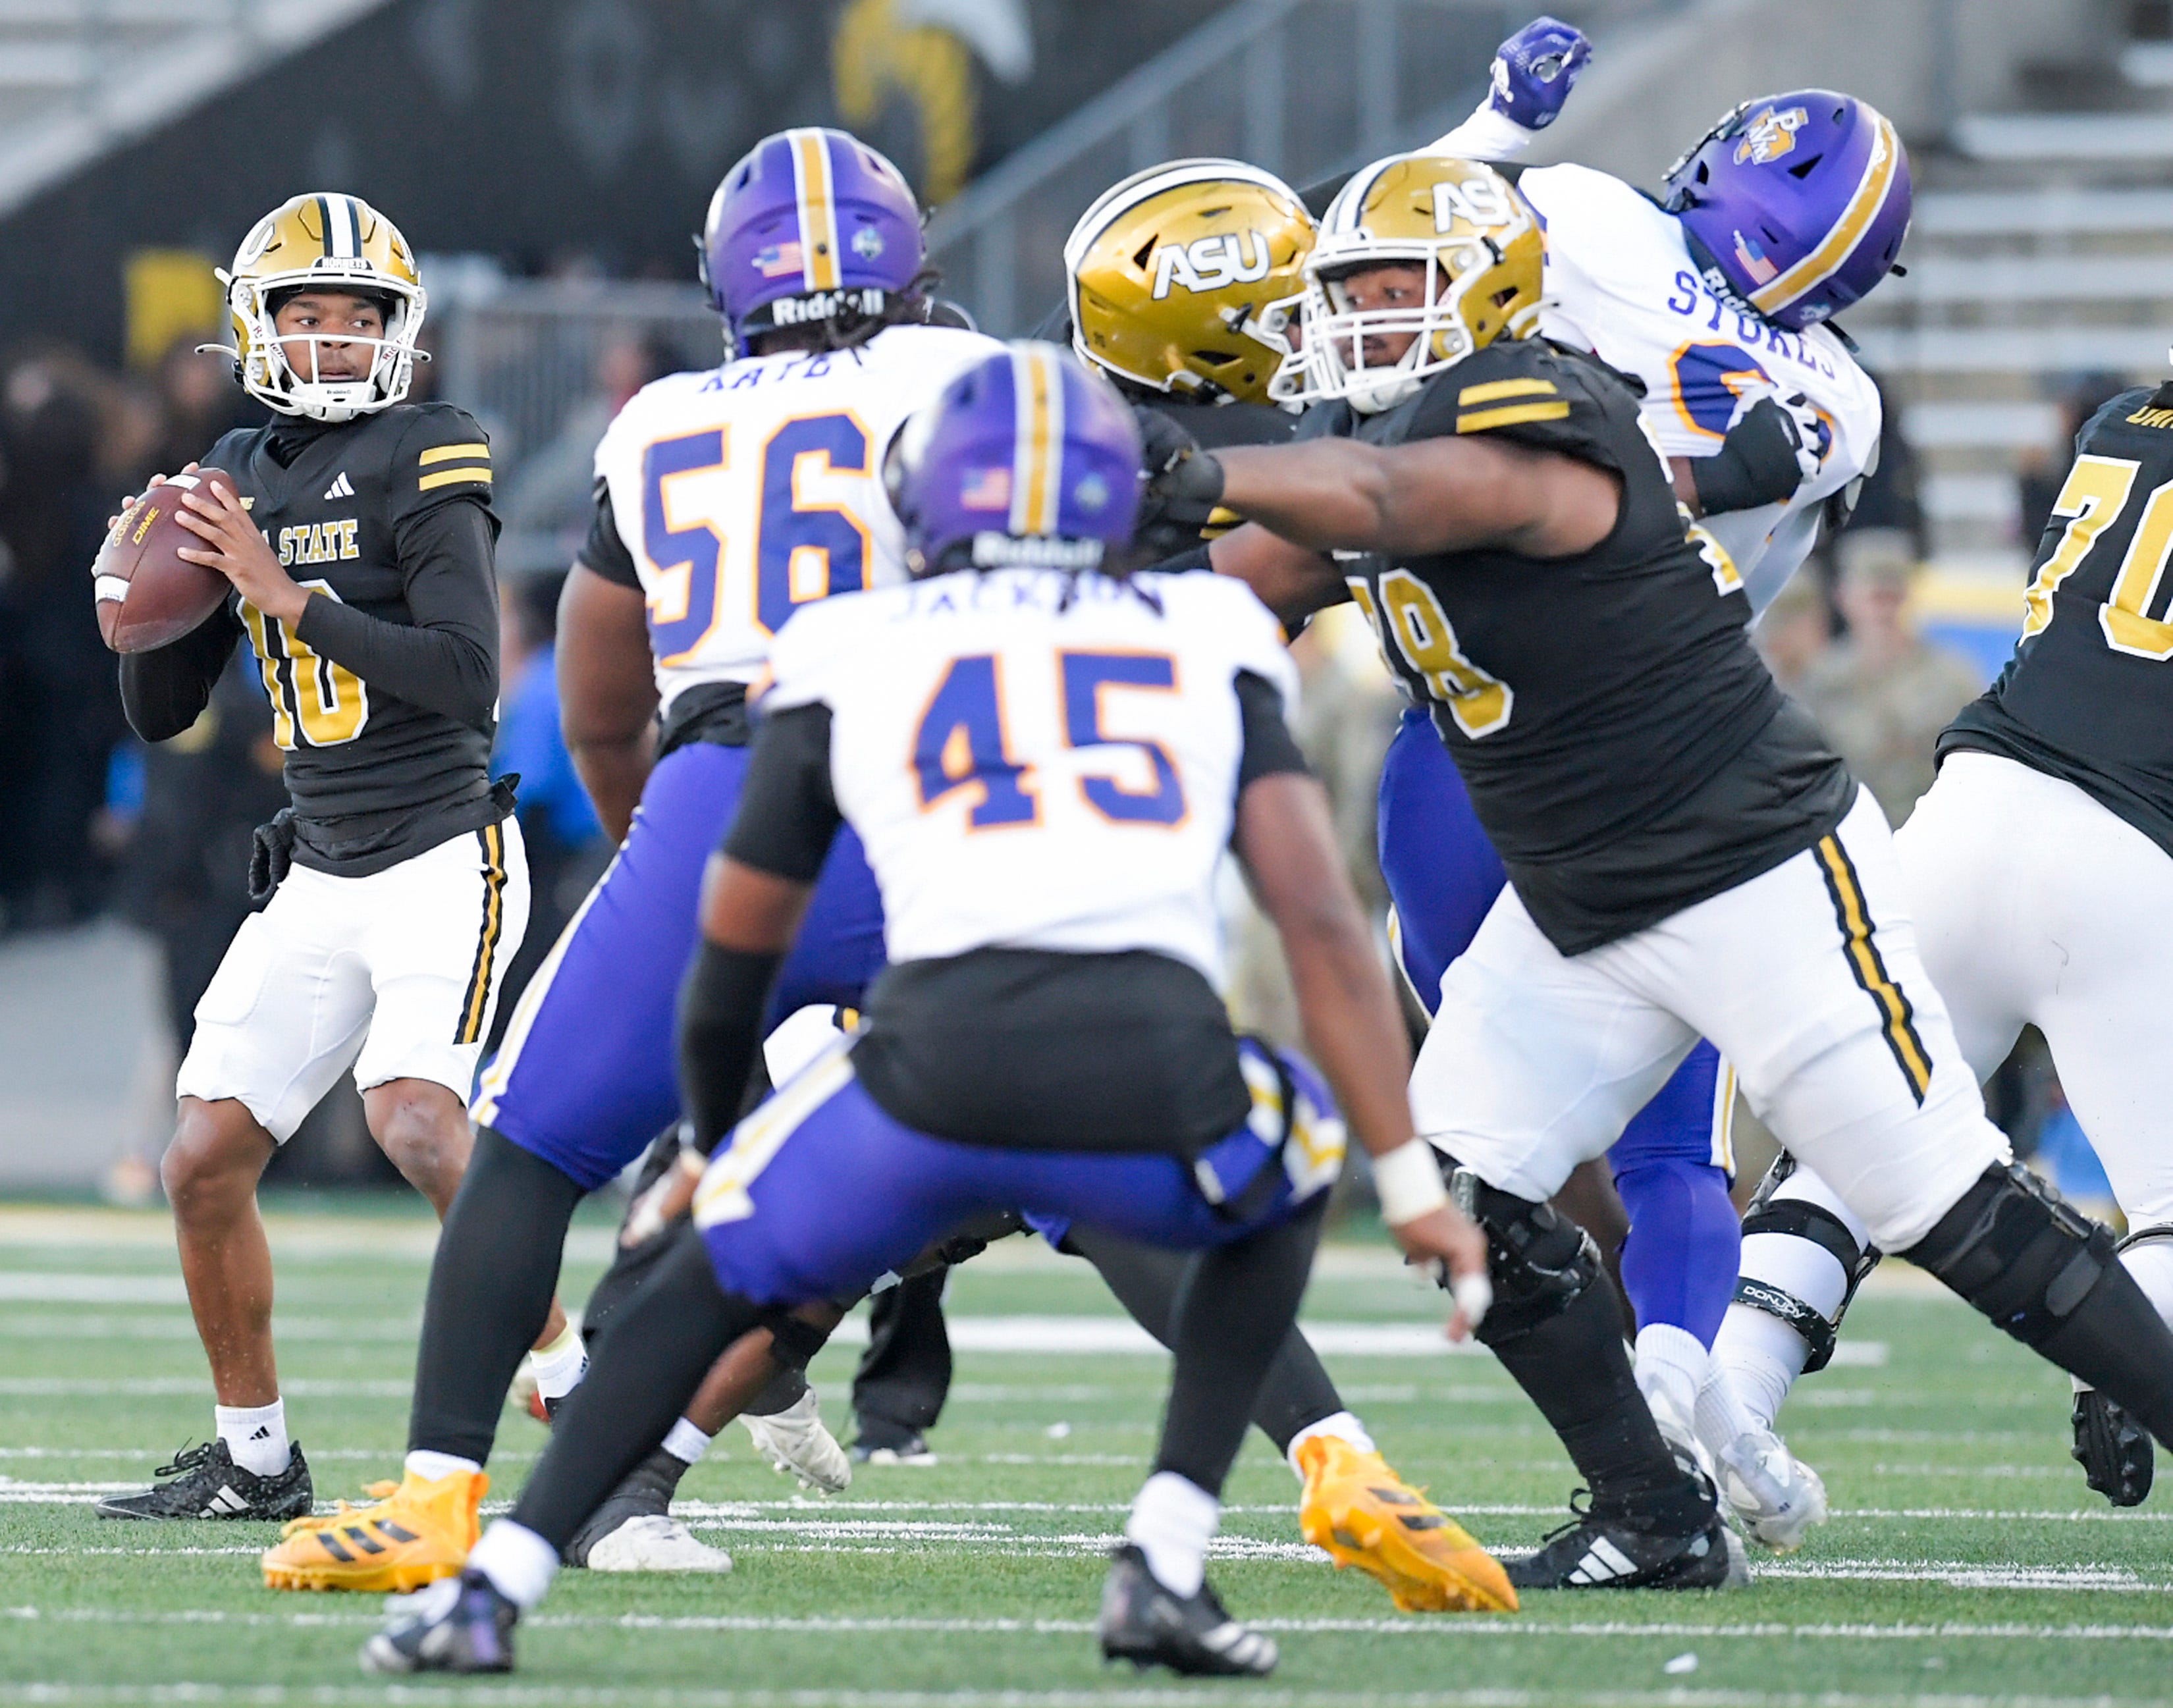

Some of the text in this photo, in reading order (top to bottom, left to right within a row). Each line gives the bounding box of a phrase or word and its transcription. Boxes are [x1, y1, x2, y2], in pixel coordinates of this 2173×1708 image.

[1152, 230, 1271, 300] ASU
[113, 500, 146, 547] adidas
[132, 506, 160, 545] DIME
[279, 519, 360, 566] STATE
[642, 406, 874, 668] 56
[2018, 454, 2173, 662] 70
[235, 578, 369, 751] 10
[1345, 567, 1515, 740] 8
[907, 647, 1191, 836] 45
[1742, 1285, 1806, 1318] DONJOY
